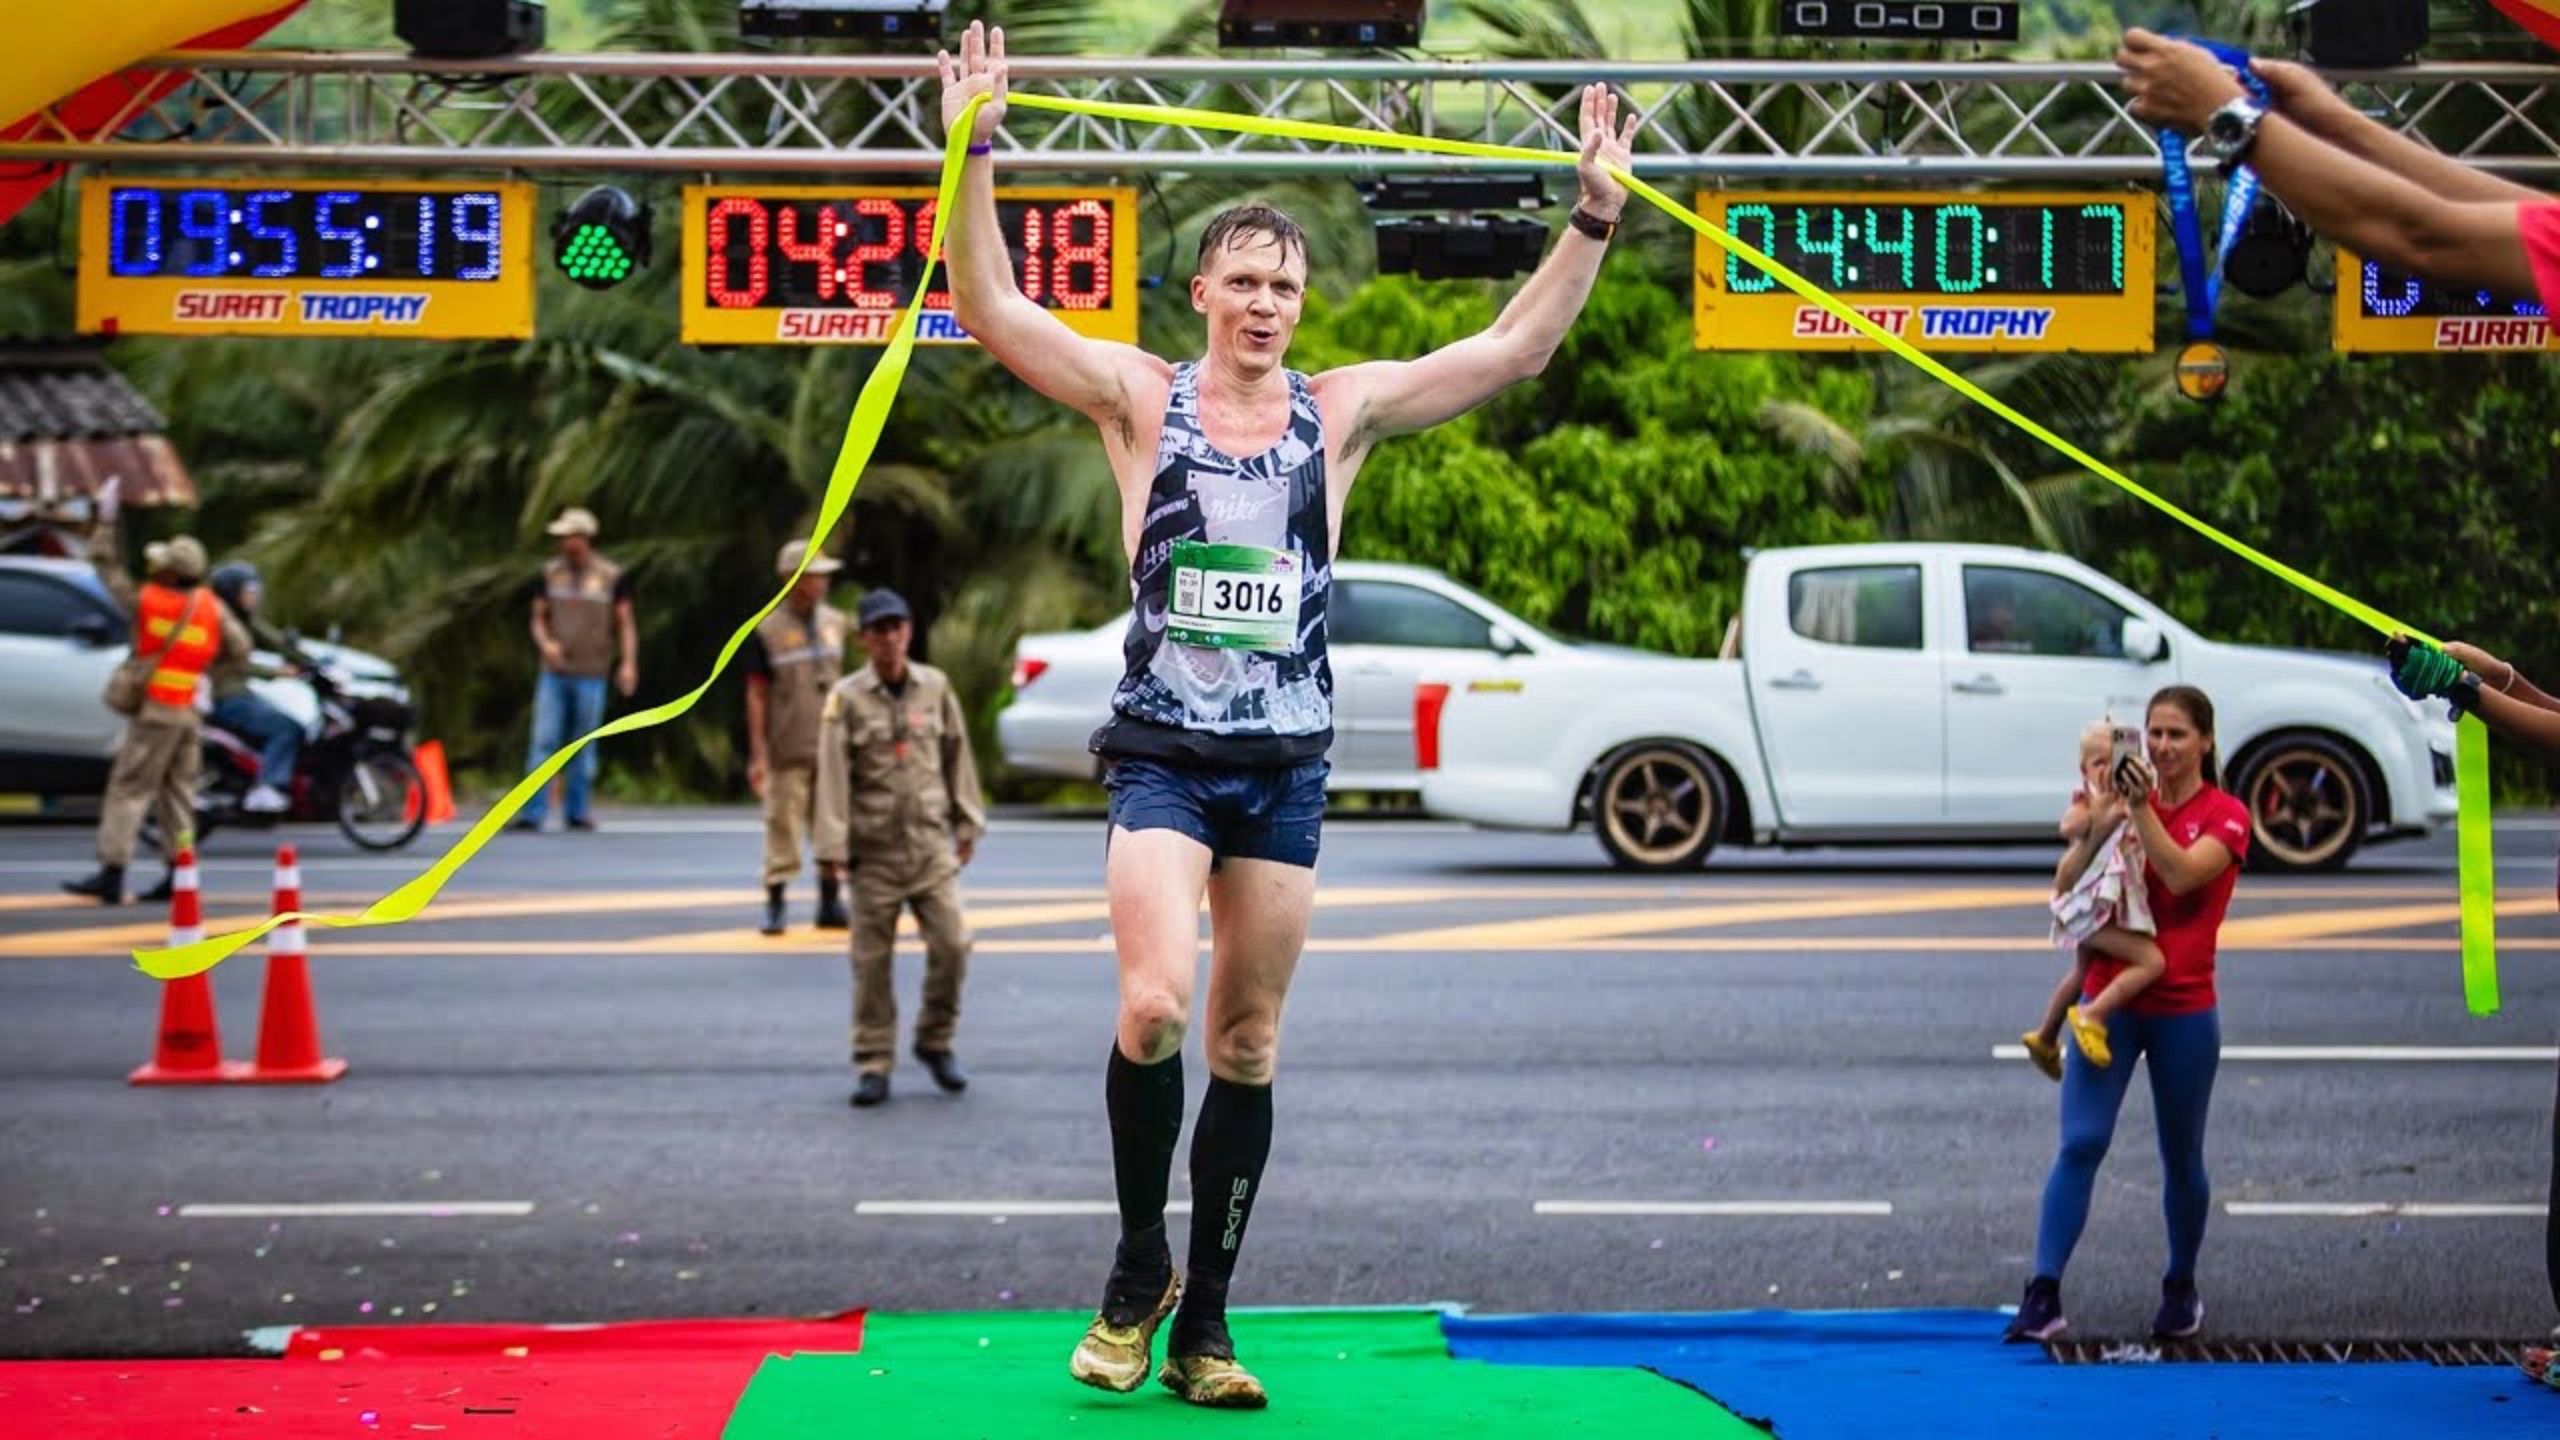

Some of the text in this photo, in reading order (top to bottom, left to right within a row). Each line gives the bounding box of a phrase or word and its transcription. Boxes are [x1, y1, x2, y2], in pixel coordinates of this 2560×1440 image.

[109, 188, 501, 280] 09:55:19
[1726, 204, 2124, 293] 04:40:17
[177, 293, 428, 321] SURAT TROPHY
[782, 312, 892, 339] SURAT
[1921, 308, 2051, 336] TROPHY
[2436, 320, 2551, 347] SURAT
[1209, 493, 1264, 522] nike
[1213, 579, 1283, 614] 3016
[1222, 1176, 1249, 1250] SKINS
